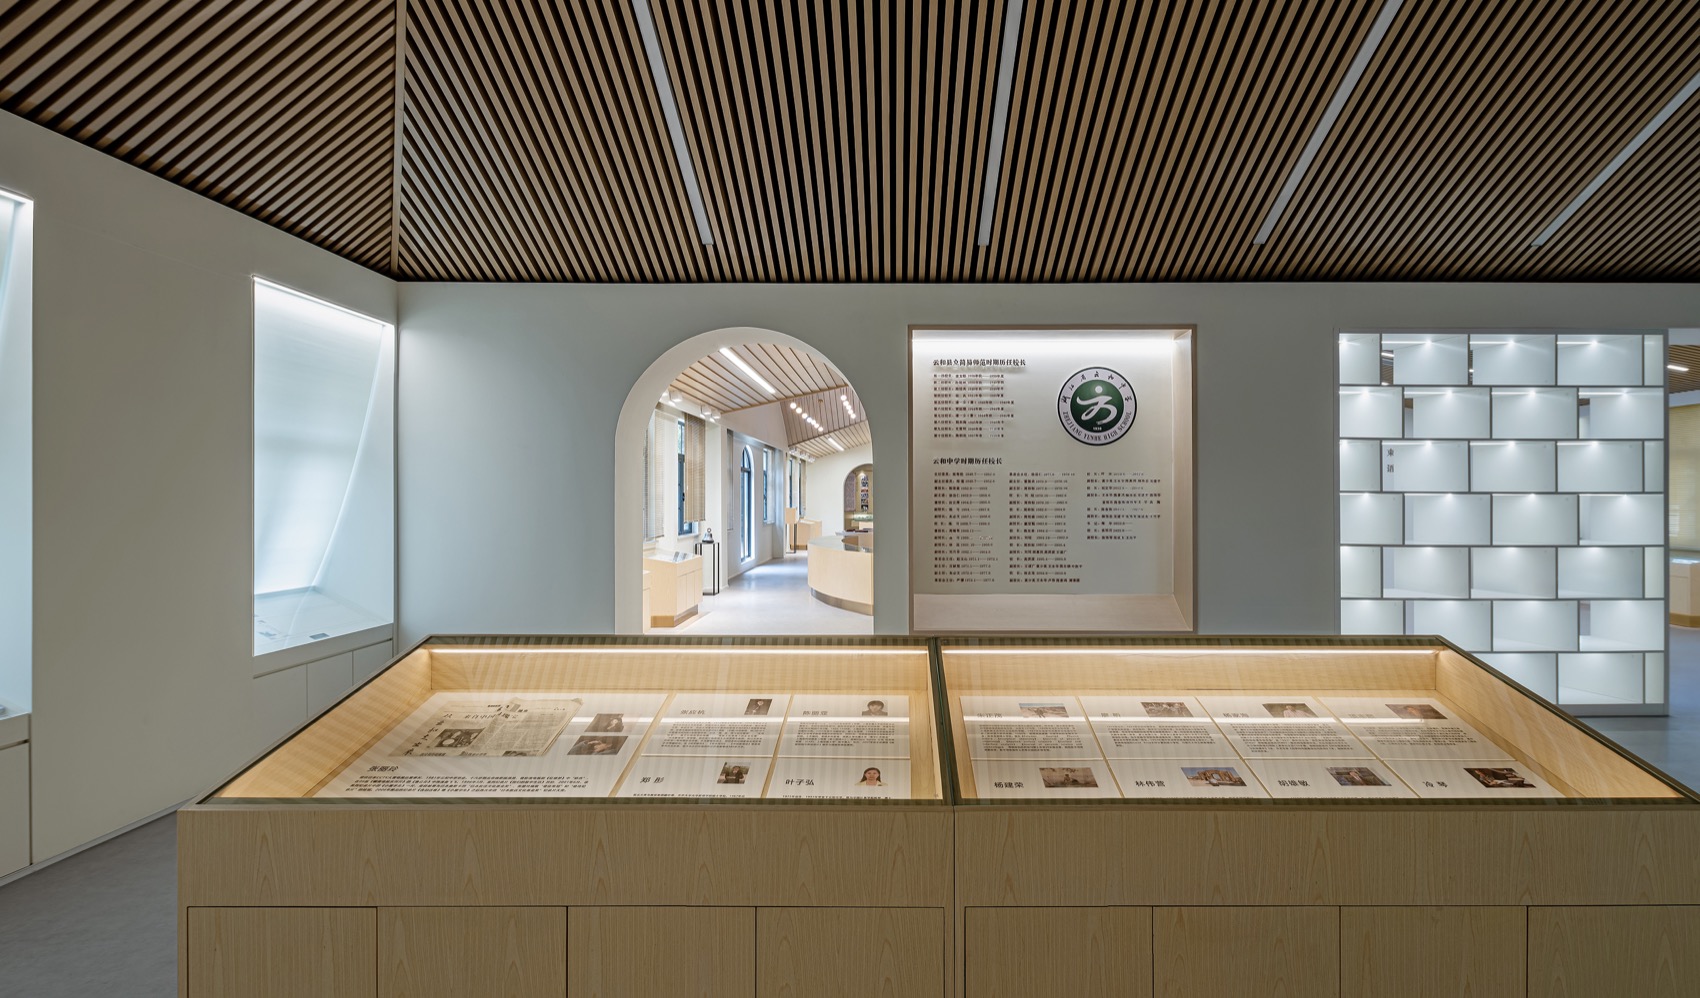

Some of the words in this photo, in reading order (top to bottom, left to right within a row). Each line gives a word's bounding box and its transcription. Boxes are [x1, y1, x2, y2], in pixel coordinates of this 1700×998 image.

[1063, 411, 1082, 436] ZHEJIANG
[1083, 433, 1102, 442] YUNHE
[1103, 430, 1118, 440] HIGH
[1117, 411, 1132, 431] SCHOOL
